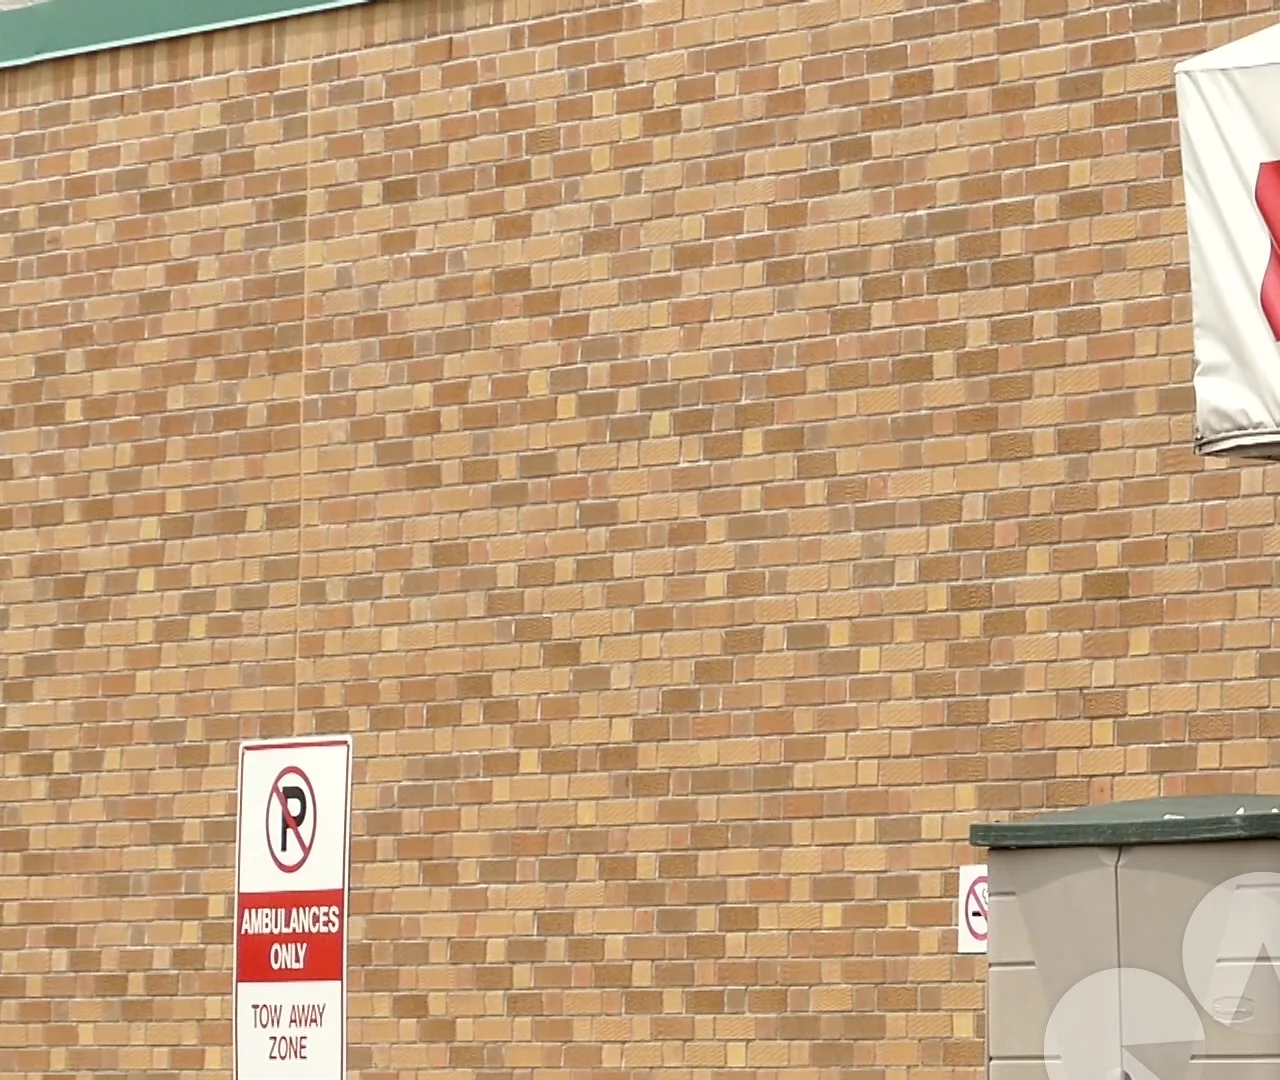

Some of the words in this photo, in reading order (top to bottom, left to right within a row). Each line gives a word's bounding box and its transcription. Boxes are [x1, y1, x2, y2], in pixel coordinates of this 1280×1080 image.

[240, 905, 340, 935] AMBULANCES
[270, 942, 307, 970] ONLY
[251, 1004, 283, 1029] TOW
[289, 1003, 326, 1028] AWAY
[268, 1035, 308, 1060] ZONE
